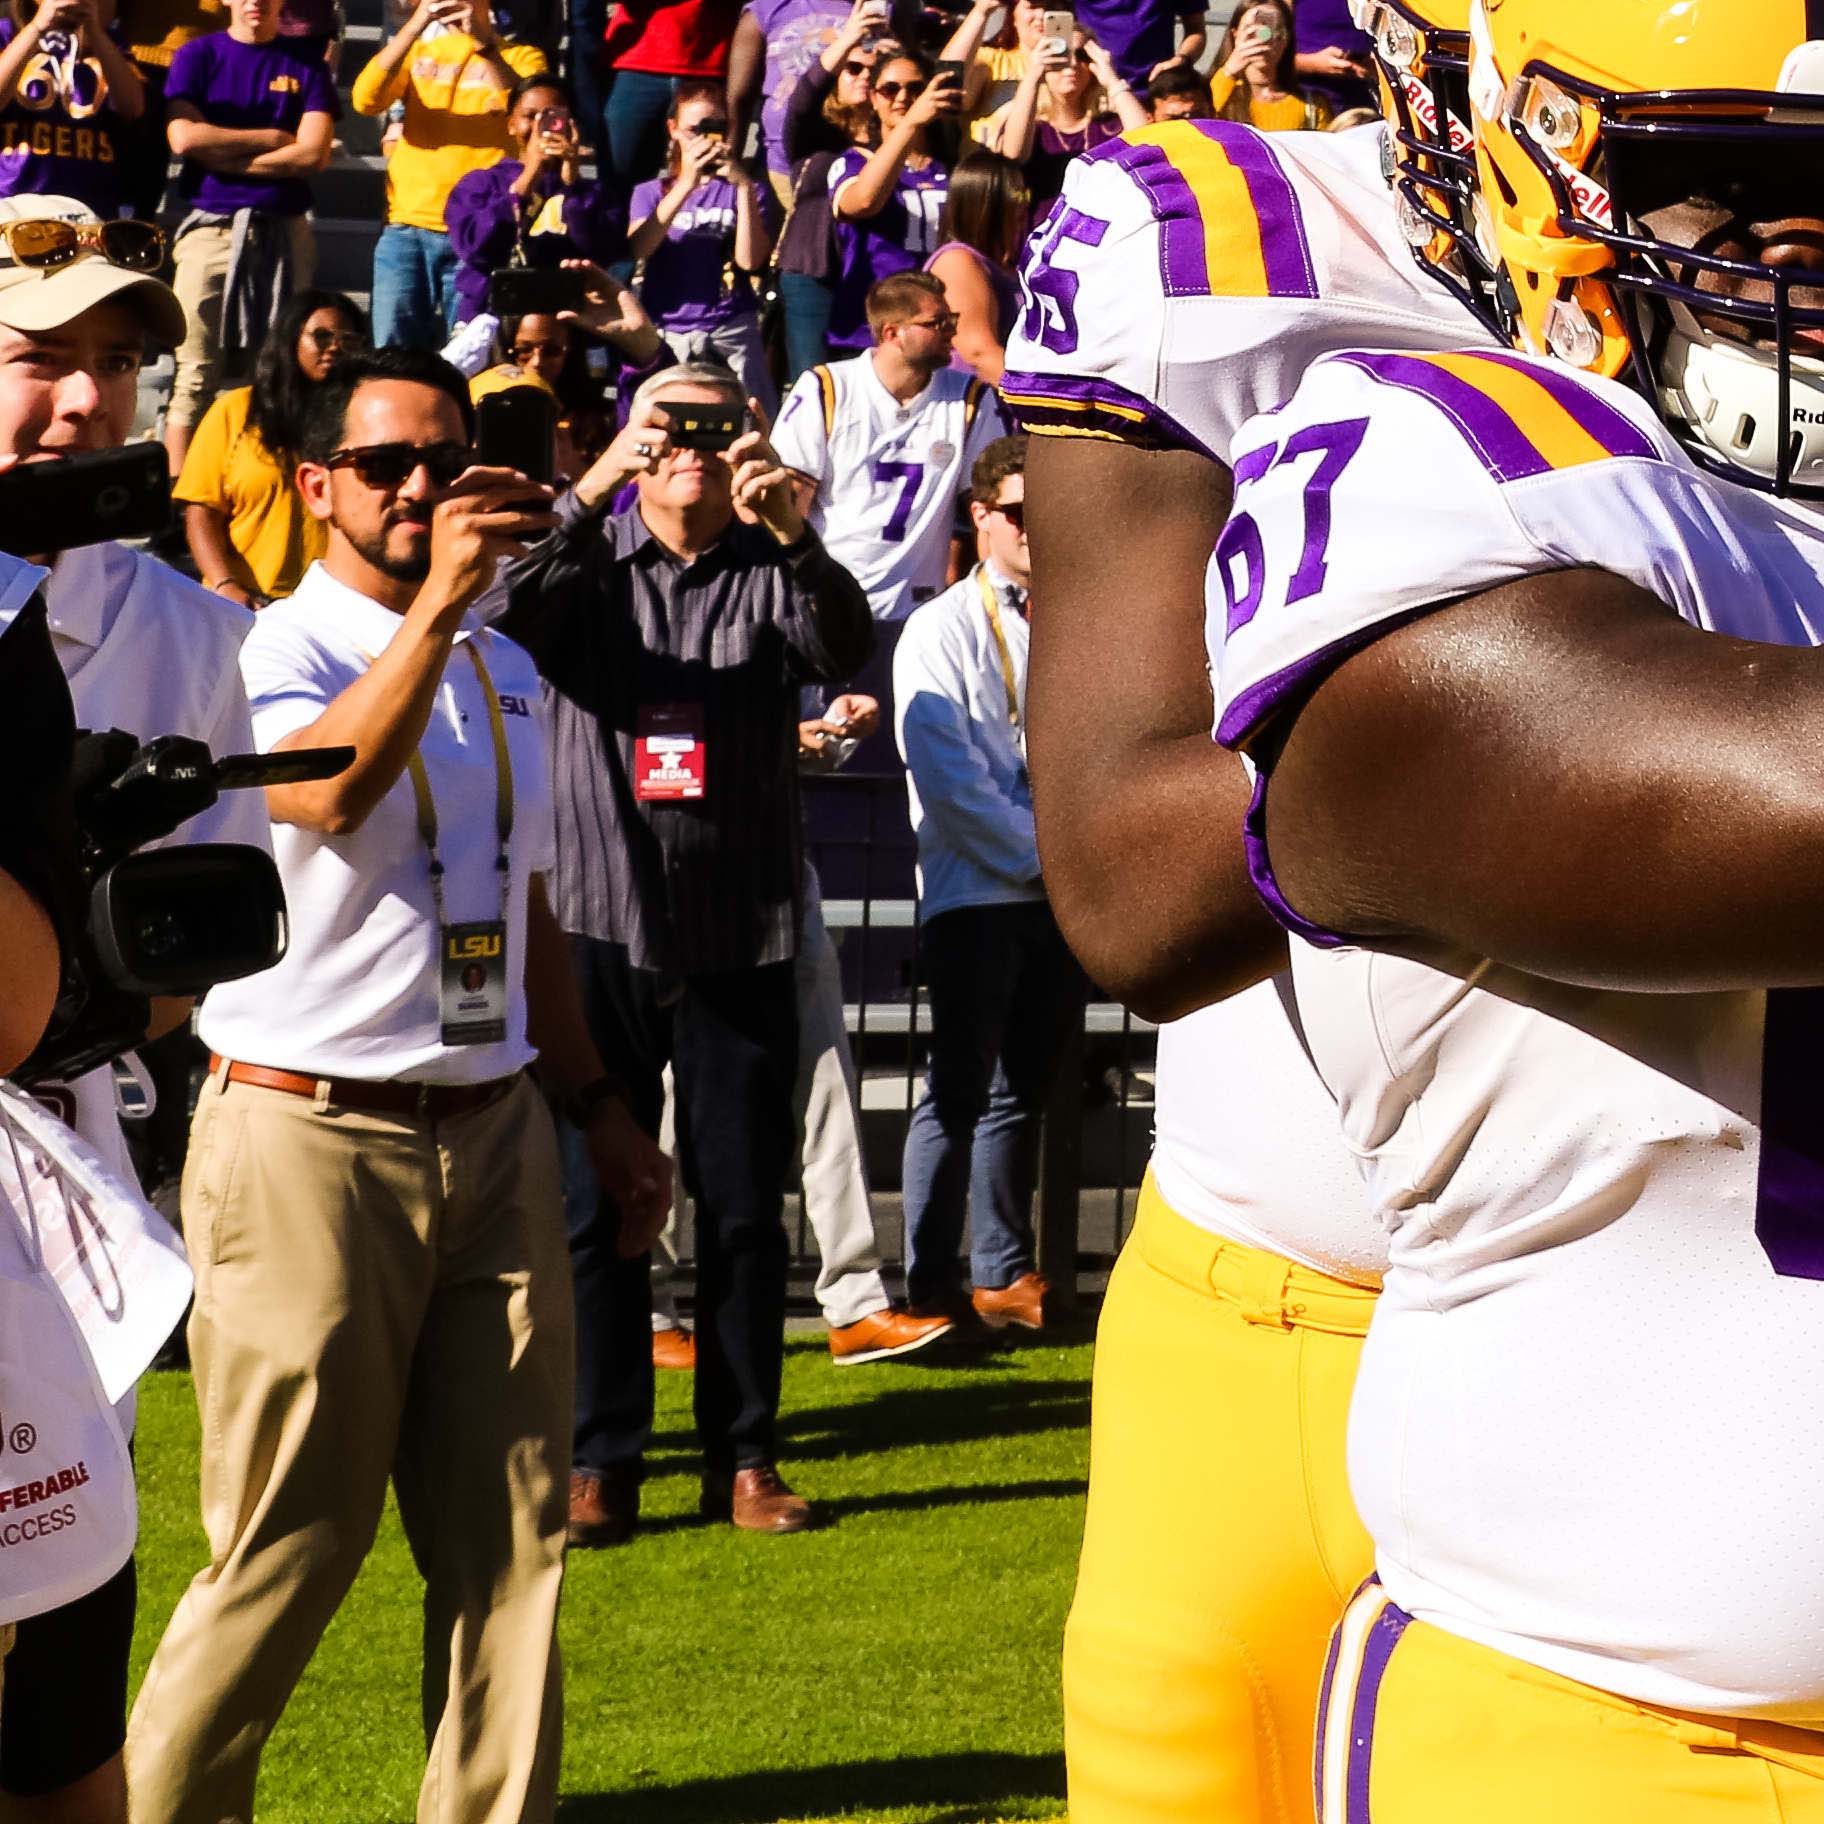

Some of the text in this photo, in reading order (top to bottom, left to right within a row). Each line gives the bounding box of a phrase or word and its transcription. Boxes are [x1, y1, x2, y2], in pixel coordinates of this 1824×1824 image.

[0, 120, 115, 163] TIGERS
[782, 395, 803, 422] 7
[874, 463, 924, 541] 7
[1215, 418, 1369, 640] 67
[171, 766, 198, 780] JVC
[648, 768, 693, 781] MEDIA
[449, 935, 501, 959] LSU
